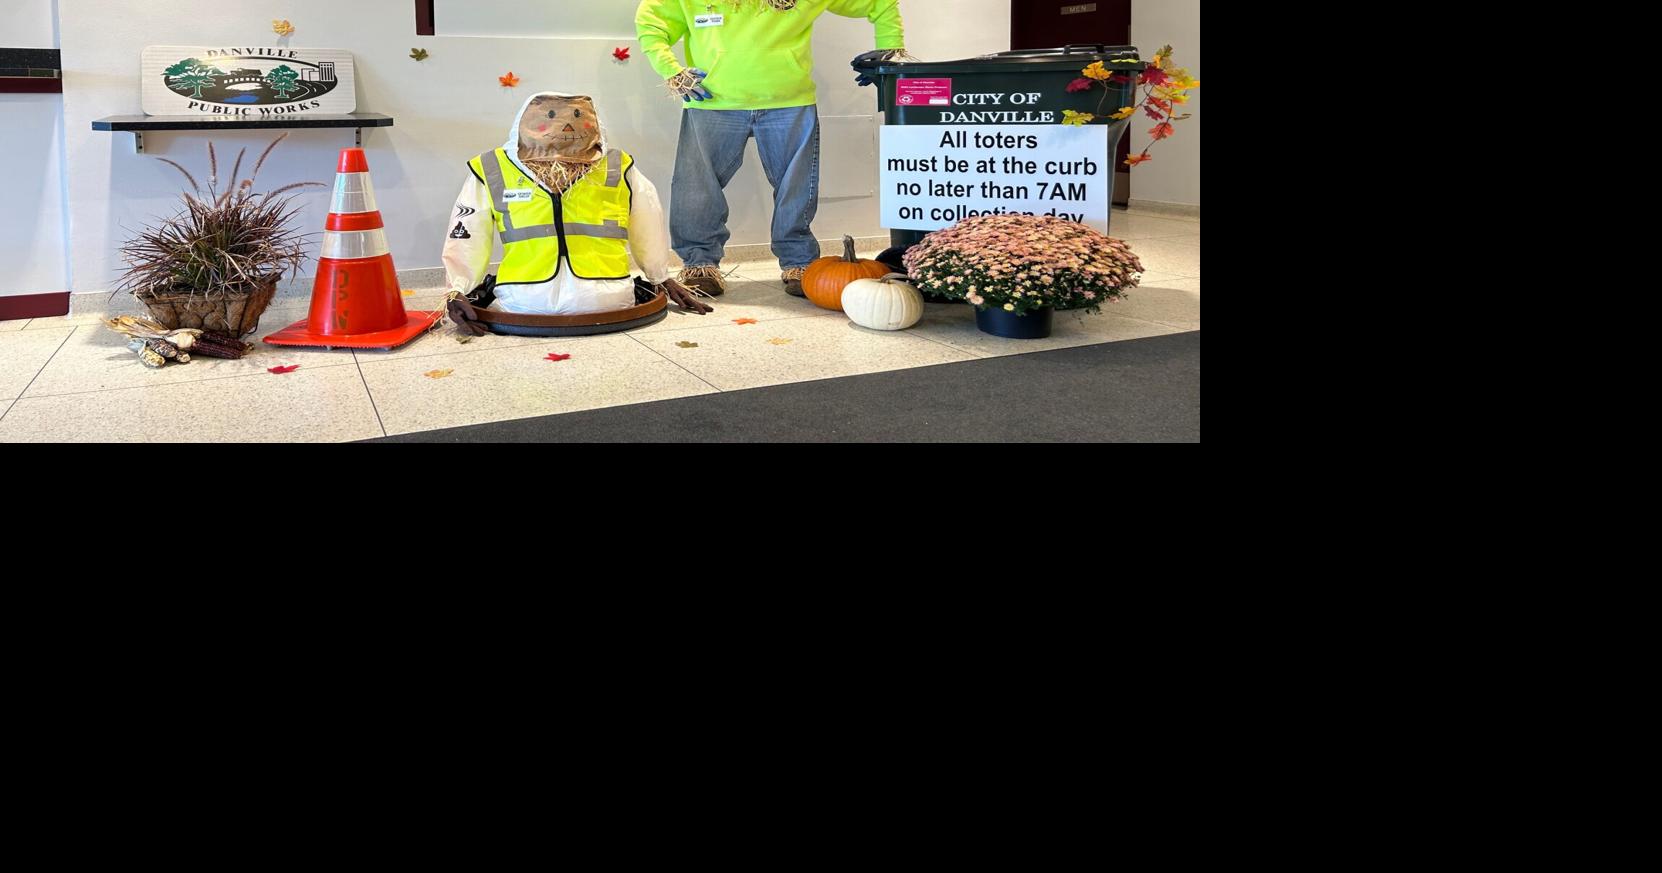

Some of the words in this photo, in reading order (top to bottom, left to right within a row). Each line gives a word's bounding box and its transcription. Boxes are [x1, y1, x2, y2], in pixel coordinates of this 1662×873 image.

[207, 47, 298, 59] DANVILLE
[952, 92, 1005, 105] CITY
[1009, 92, 1042, 105] OF
[187, 101, 251, 115] PUBLIC
[258, 100, 320, 115] WORKS
[939, 111, 1054, 123] DANVILLE
[939, 131, 967, 148] All
[974, 132, 1038, 149] toters
[887, 156, 938, 173] must
[944, 155, 969, 173] be
[976, 158, 996, 174] at
[1002, 156, 1037, 174] the
[1045, 157, 1098, 176] curb
[896, 182, 921, 196] no
[928, 180, 975, 198] later
[981, 181, 1029, 199] than
[1036, 182, 1087, 201] 7AM
[899, 206, 923, 220] on
